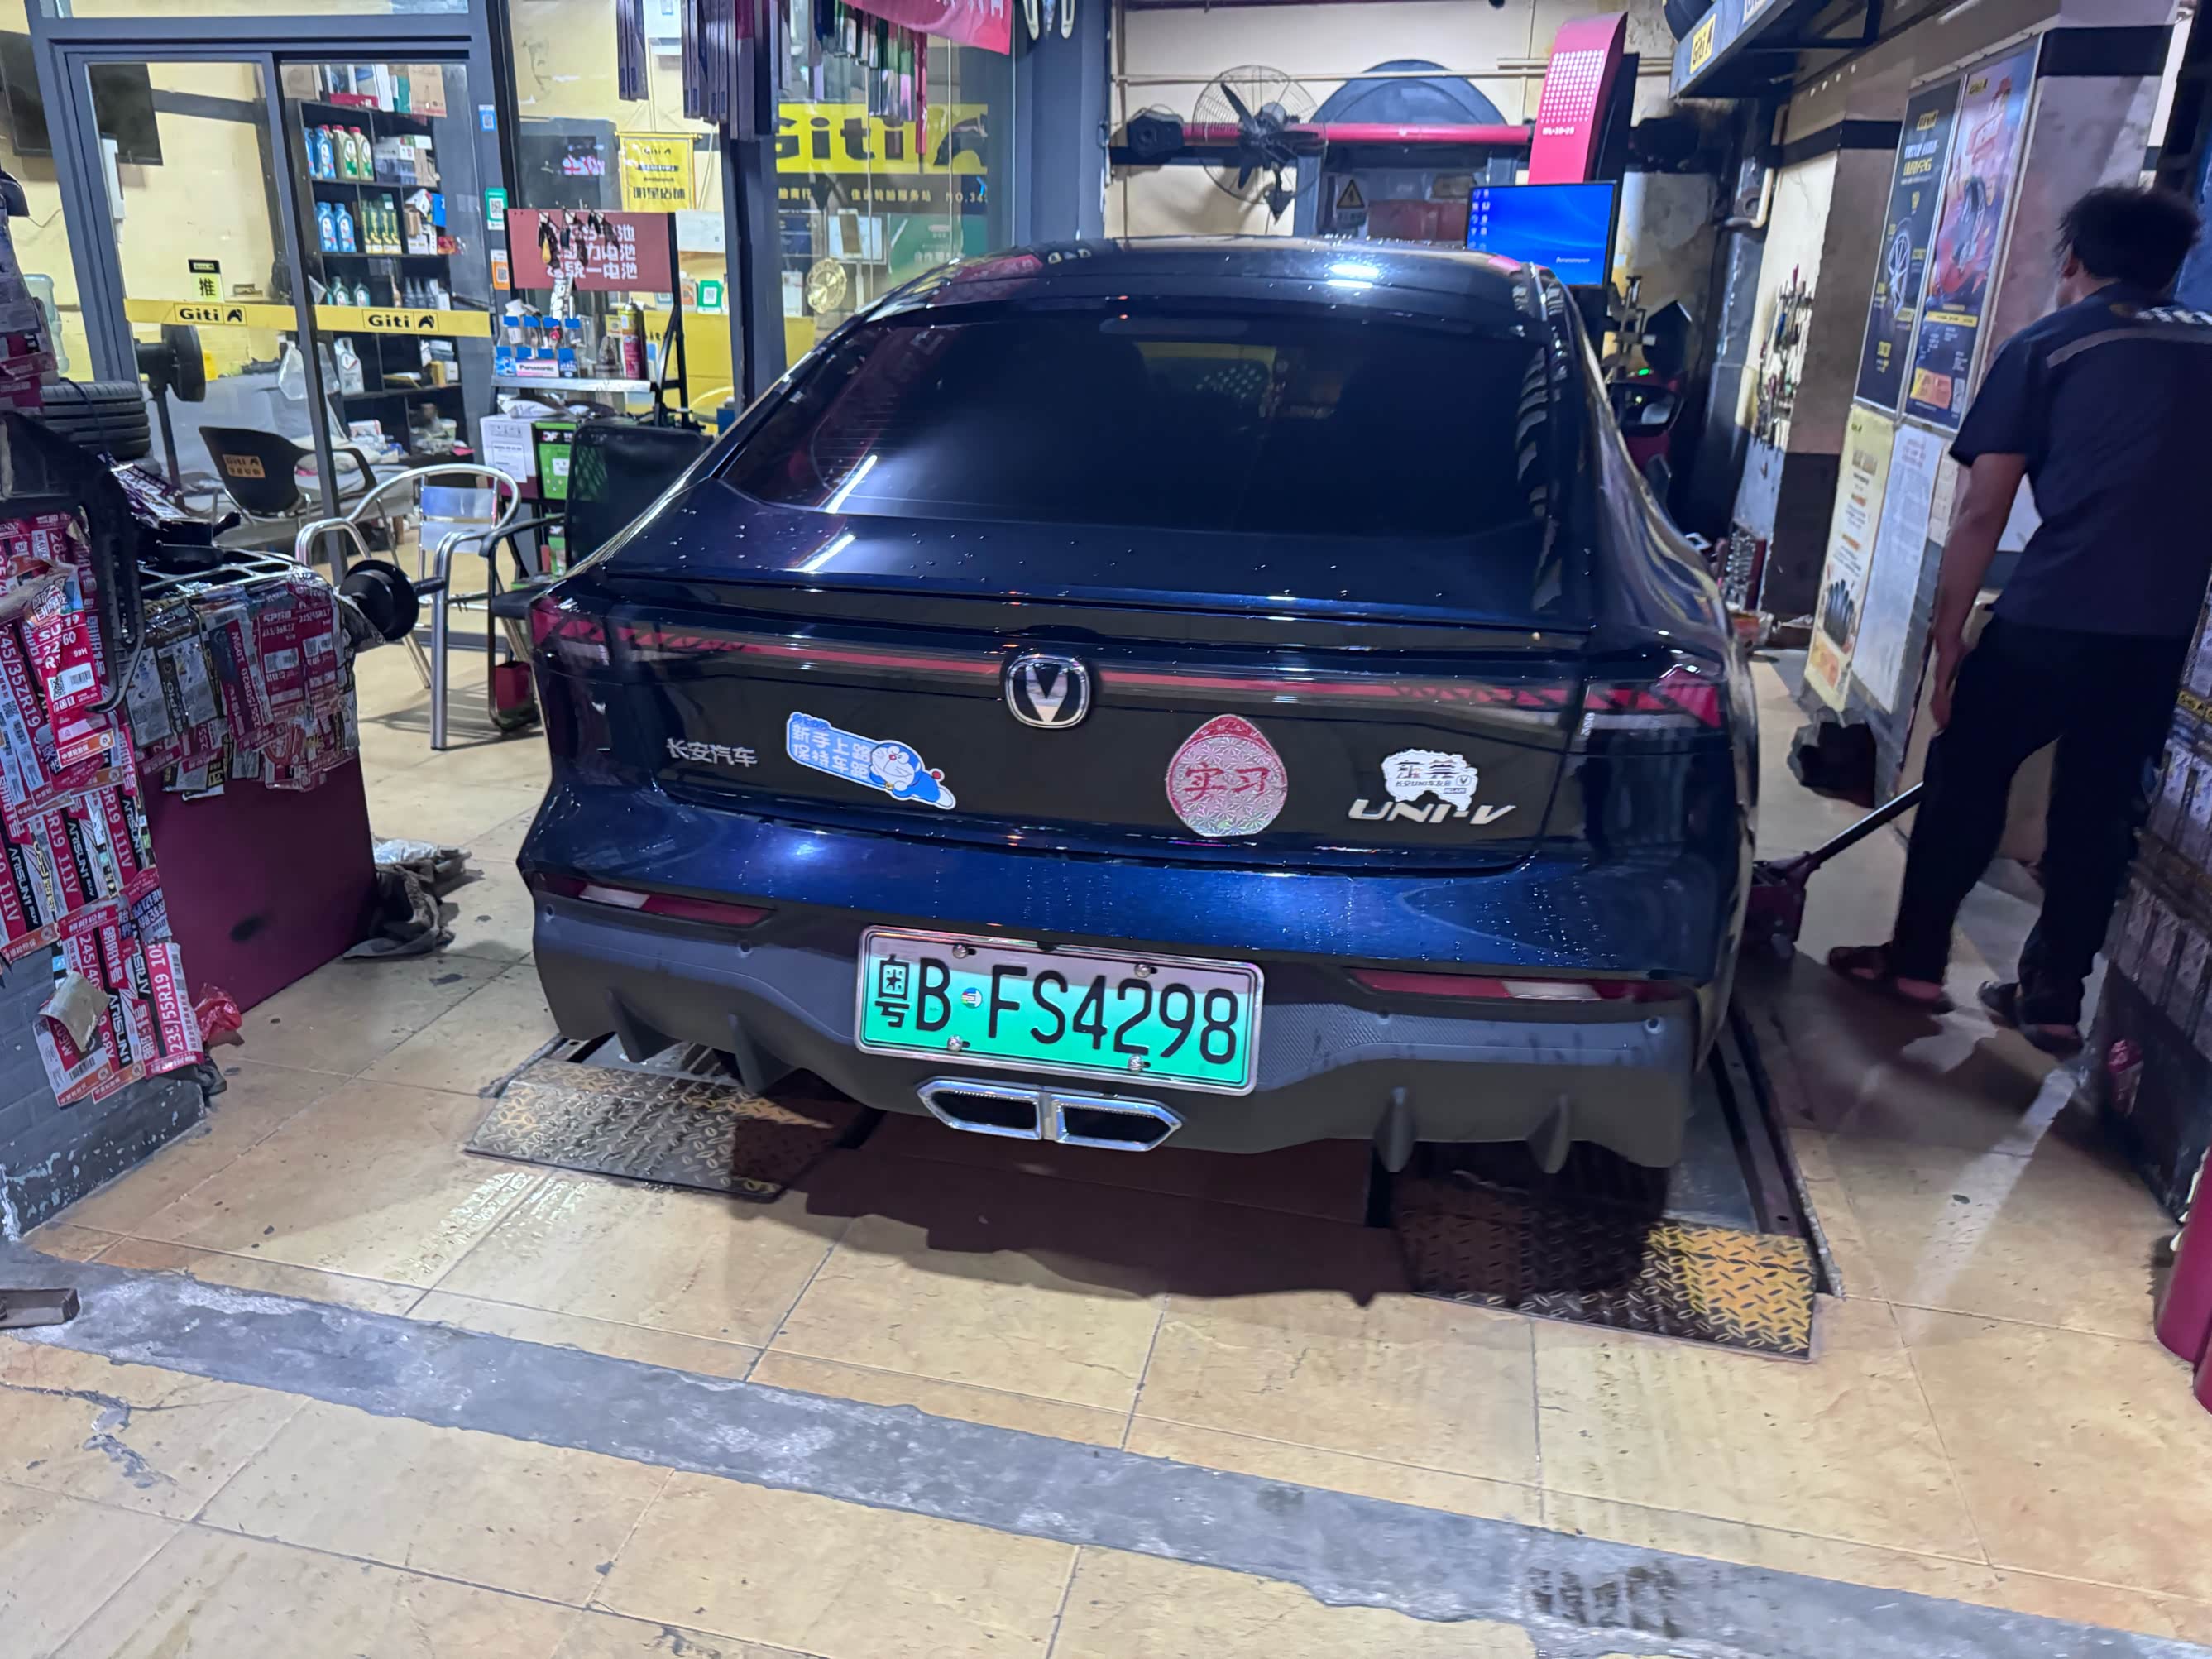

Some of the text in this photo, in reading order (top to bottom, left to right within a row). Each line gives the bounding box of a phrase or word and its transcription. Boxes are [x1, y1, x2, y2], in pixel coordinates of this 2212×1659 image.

[199, 278, 216, 296] 推
[179, 308, 219, 322] Giti
[368, 314, 410, 328] Giti
[519, 364, 554, 372] Panasonic
[667, 737, 758, 768] 长安汽车
[792, 724, 871, 761] 新手上路
[792, 744, 869, 779] 保持车距
[1183, 761, 1271, 803] 实习
[1348, 798, 1516, 826] UNI-V
[67, 822, 95, 897] ARISUN1 SUV
[113, 829, 133, 868] 111V
[8, 847, 39, 925] ARISUN1 SUV
[58, 855, 79, 894] 111V
[103, 924, 124, 984] 朝阳1号
[108, 994, 132, 1064] ARISUN1
[154, 973, 184, 1053] 235/55R19
